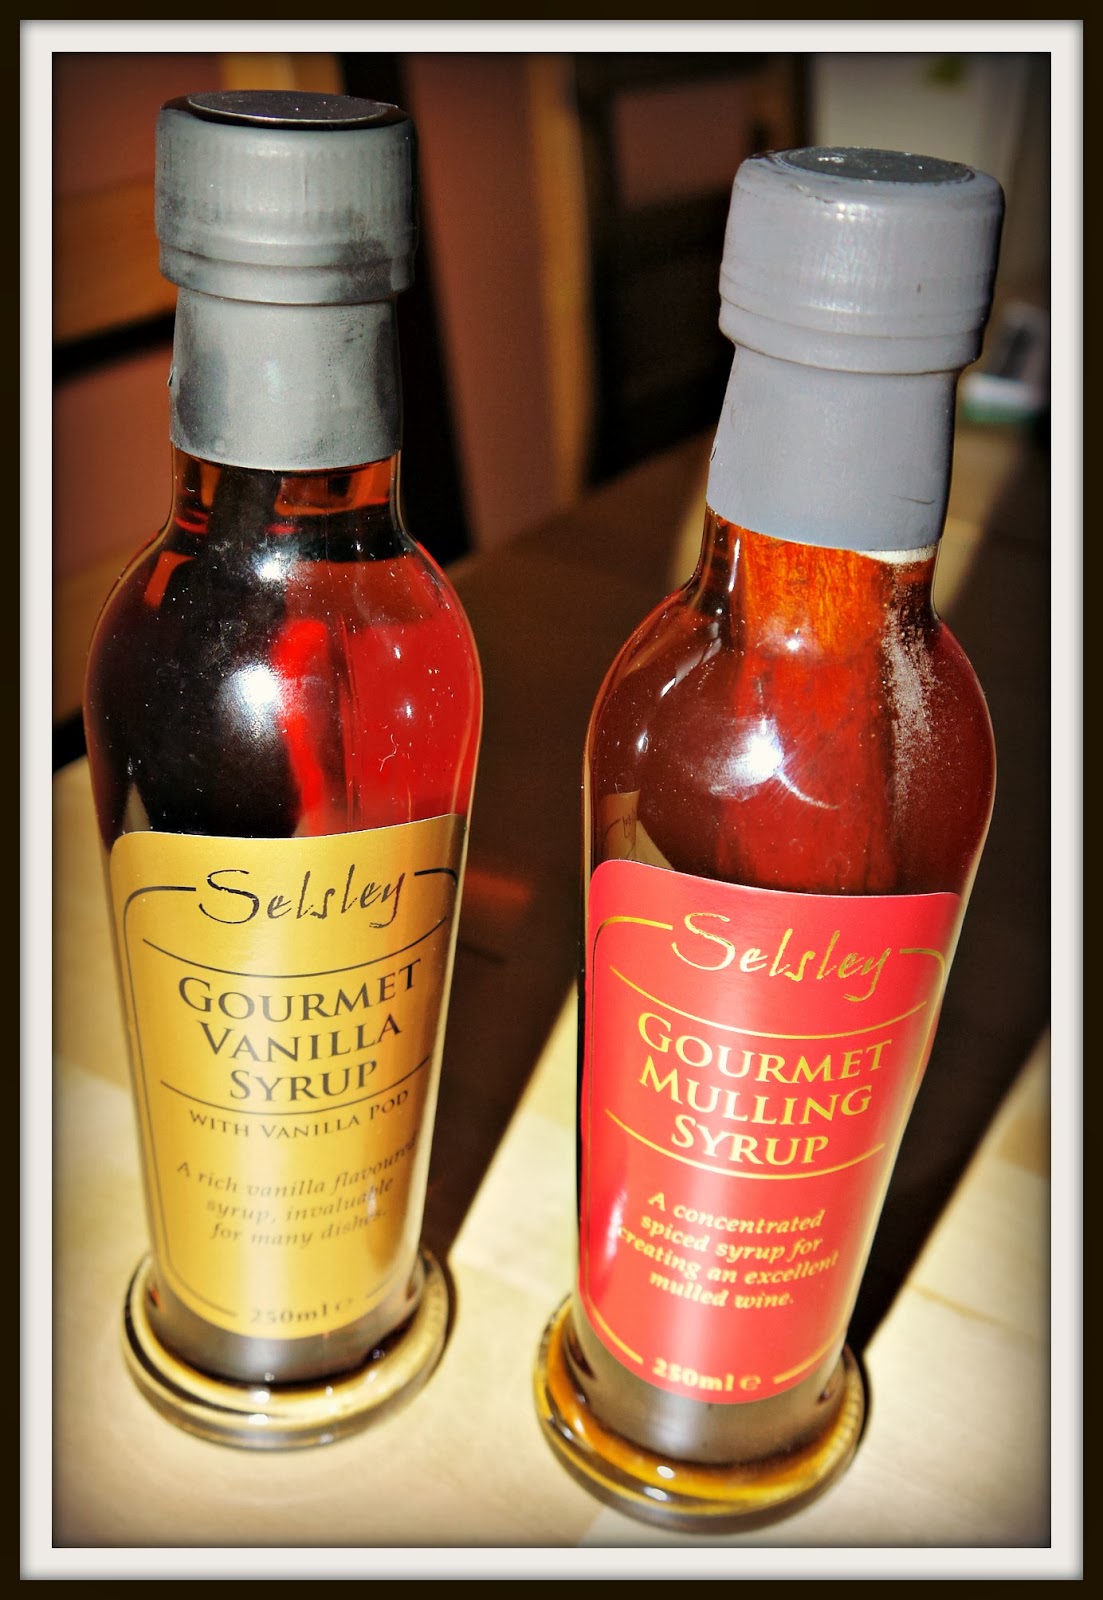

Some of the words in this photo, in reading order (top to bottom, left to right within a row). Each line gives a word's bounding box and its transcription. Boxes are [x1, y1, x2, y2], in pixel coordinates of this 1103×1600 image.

[198, 864, 406, 929] Selsley
[671, 911, 892, 1002] Selsley
[178, 959, 422, 1024] GOURMET
[196, 1013, 403, 1063] VANILLA
[638, 1011, 892, 1085] GOURMET
[230, 1060, 377, 1101] SYRUP
[638, 1055, 873, 1126] MULLING
[189, 1109, 250, 1137] WITH
[260, 1115, 360, 1139] VANILLA
[671, 1113, 829, 1167] SYRUP
[177, 1161, 191, 1178] A
[197, 1172, 238, 1193] rich
[246, 1178, 325, 1198] vanilla
[207, 1200, 277, 1224] syrup,
[285, 1176, 394, 1222] invaluable
[210, 1222, 242, 1240] for
[250, 1231, 314, 1248] many
[648, 1192, 666, 1211] A
[673, 1204, 825, 1236] concentrated
[617, 1226, 702, 1281] creating
[706, 1266, 737, 1284] an
[744, 1250, 839, 1285] excellent
[640, 1214, 710, 1252] spiced
[715, 1241, 785, 1264] syrup
[788, 1237, 823, 1263] for
[250, 1302, 329, 1325] 250ml
[650, 1269, 729, 1308] mulled
[734, 1291, 795, 1310] wine.
[652, 1357, 734, 1392] 250ml
